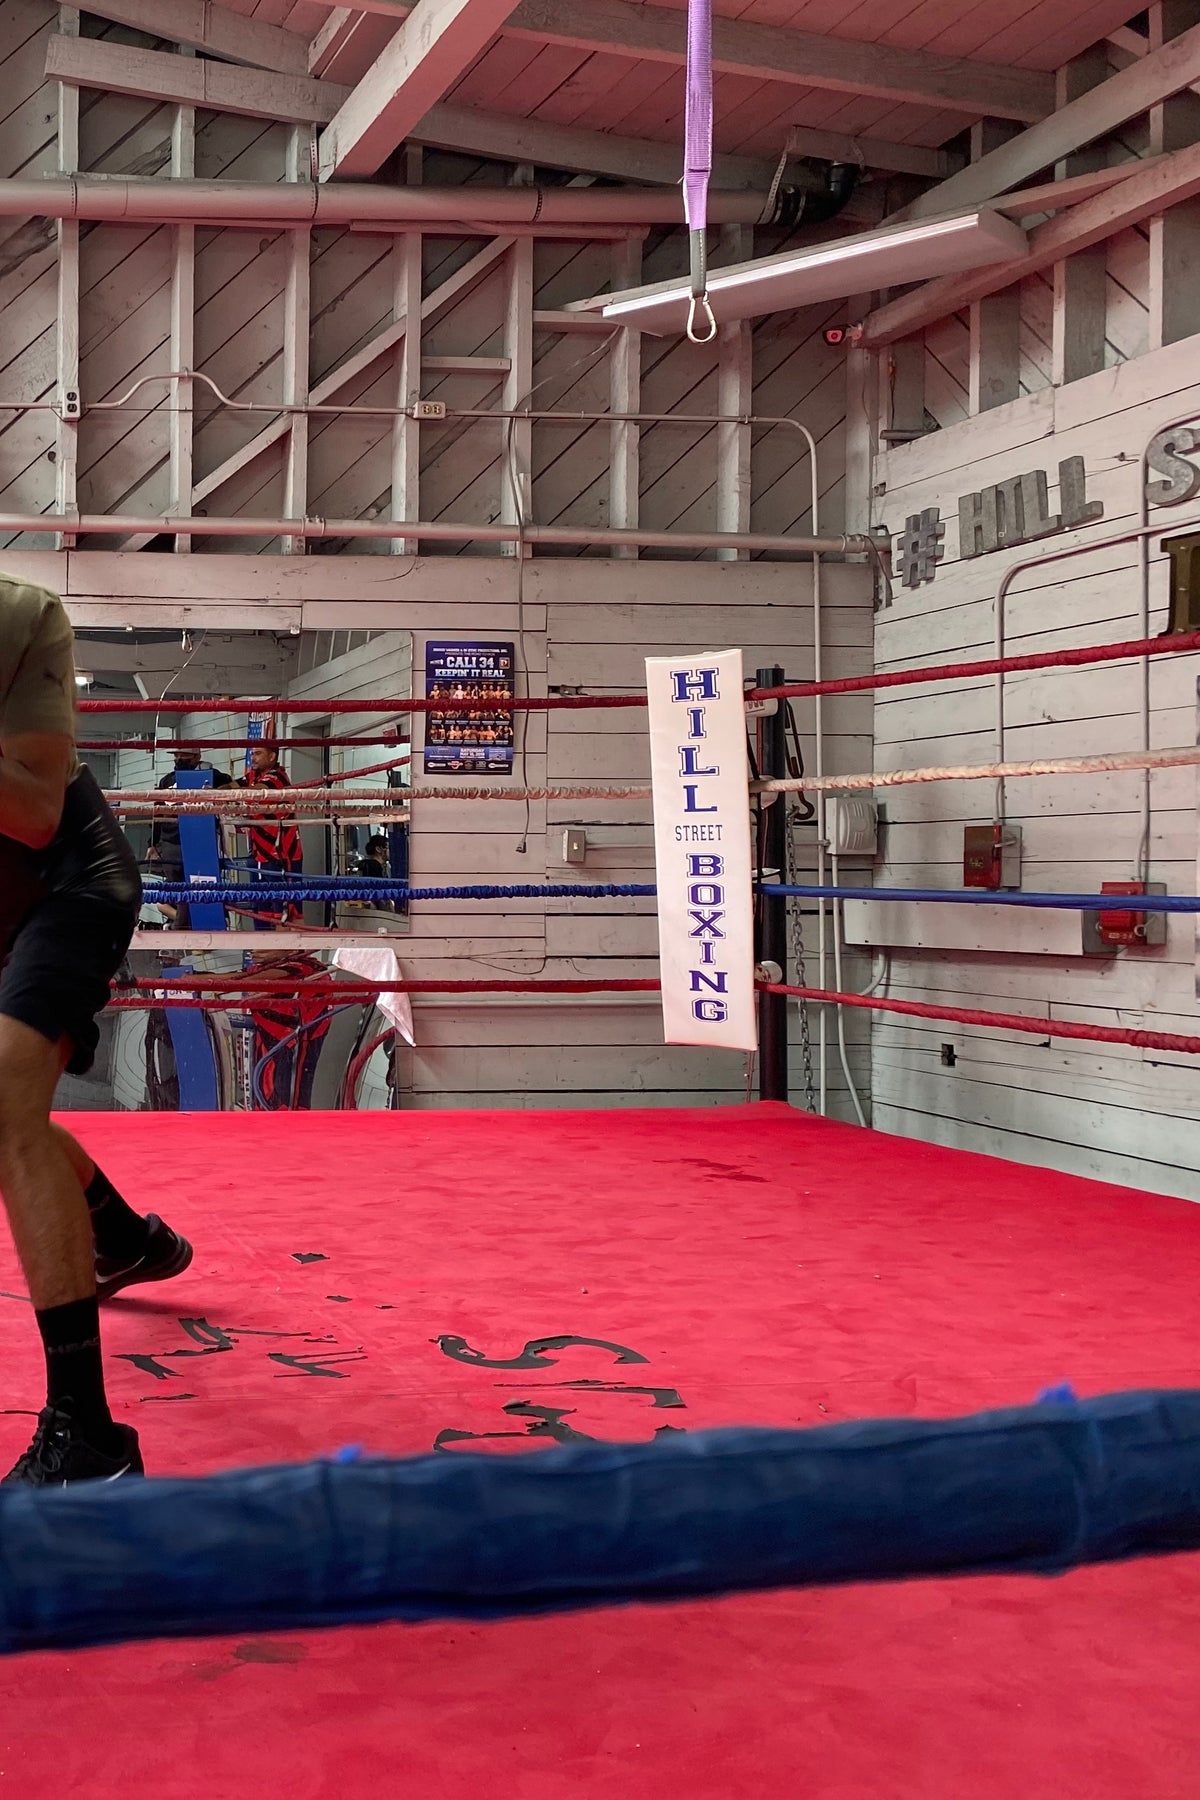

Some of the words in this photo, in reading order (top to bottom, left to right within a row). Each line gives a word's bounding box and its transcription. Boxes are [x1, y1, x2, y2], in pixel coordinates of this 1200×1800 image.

[958, 455, 1104, 559] HILL
[1145, 427, 1200, 508] S
[435, 668, 469, 677] KEEPIN'
[471, 669, 480, 677] IT
[482, 670, 506, 678] REAL
[446, 656, 477, 669] CALI
[479, 657, 495, 669] 34
[669, 667, 721, 813] HILL
[675, 825, 723, 842] STREET
[685, 852, 729, 1024] BOXING
